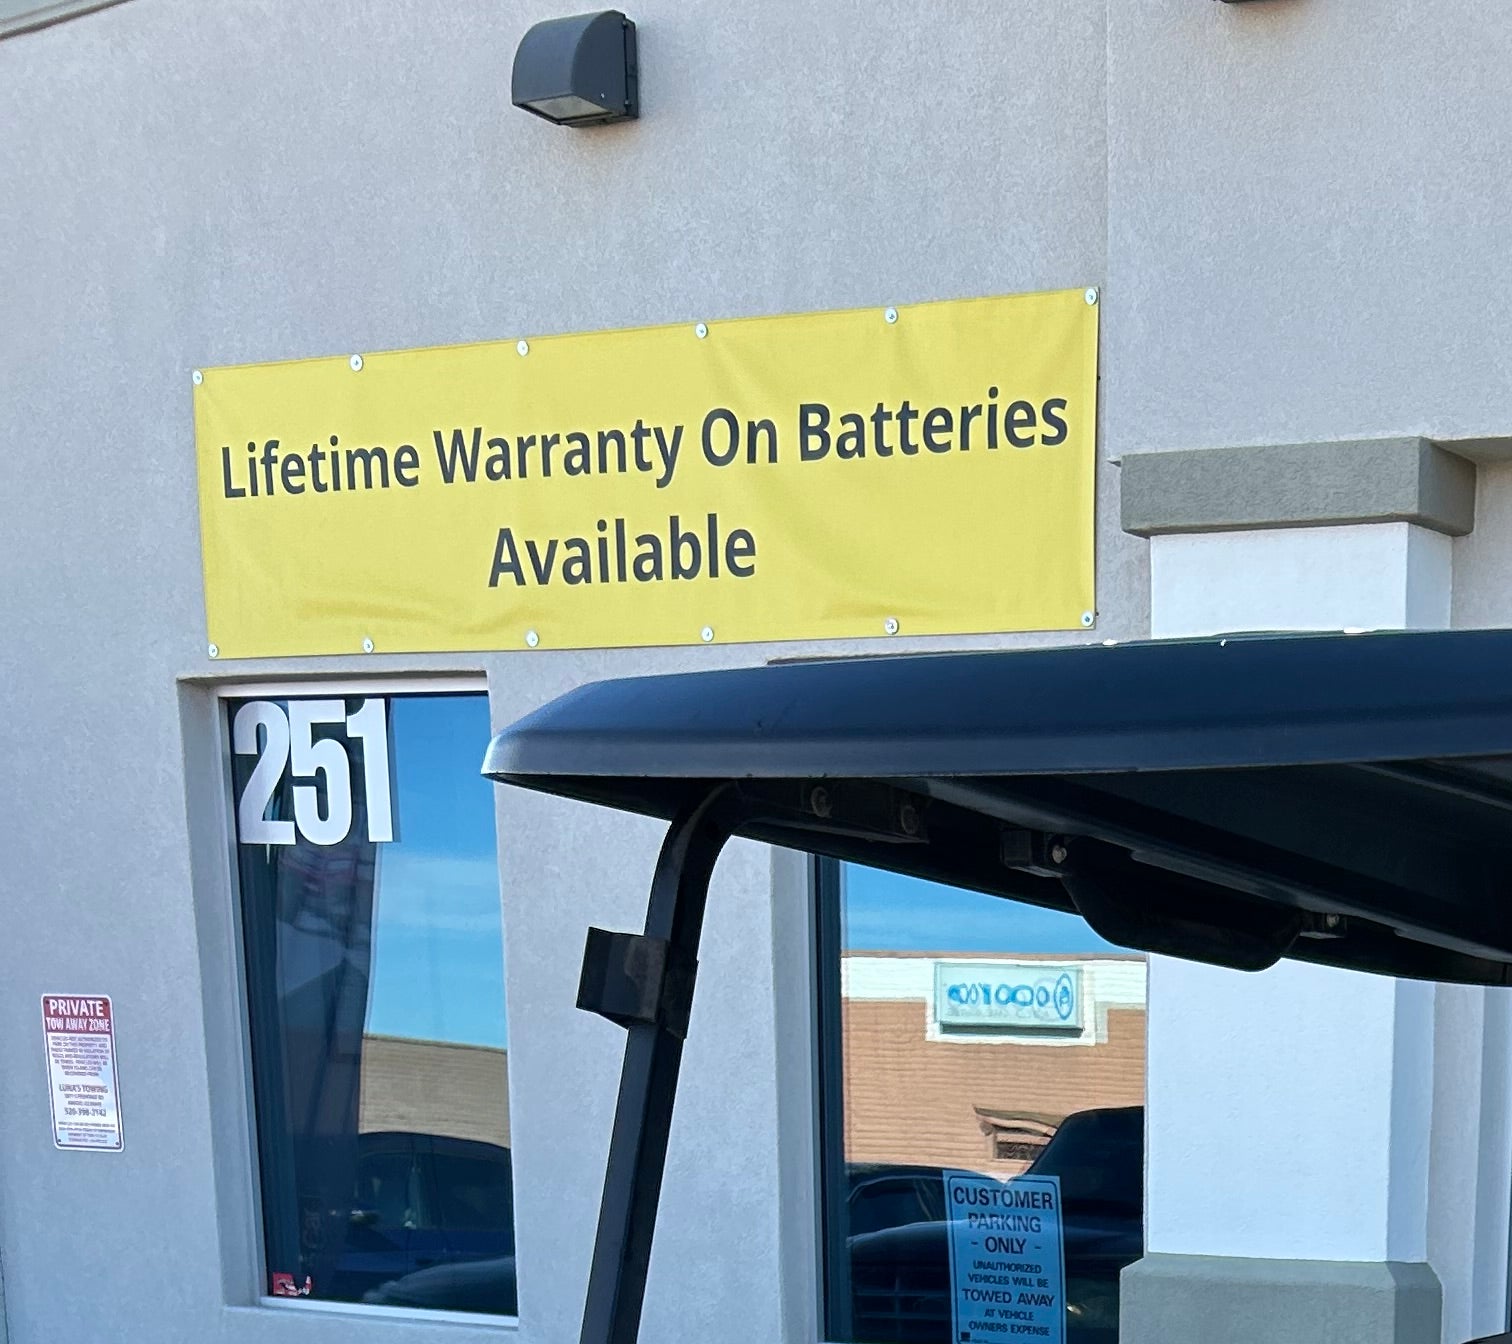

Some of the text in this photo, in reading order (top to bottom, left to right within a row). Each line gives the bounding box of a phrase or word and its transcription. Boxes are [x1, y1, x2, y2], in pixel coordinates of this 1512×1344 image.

[222, 386, 1068, 499] Lifetime Warranty On Batteries
[488, 513, 756, 588] Available
[233, 698, 393, 845] 251
[49, 999, 104, 1017] PRIVATE
[46, 1017, 110, 1032] TOW AWAY ZONE
[953, 1186, 1053, 1210] CUSTOMER
[968, 1212, 1041, 1233] PARKING
[985, 1236, 1027, 1254] ONLY
[973, 1260, 1042, 1274] UNAUTHORIZED
[968, 1273, 1049, 1288] VEHICLES WILL BE
[962, 1289, 1055, 1307] TOWED AWAY
[984, 1308, 1034, 1321] AT VEHICLE
[968, 1320, 1051, 1337] OWNERS EXPENSE
